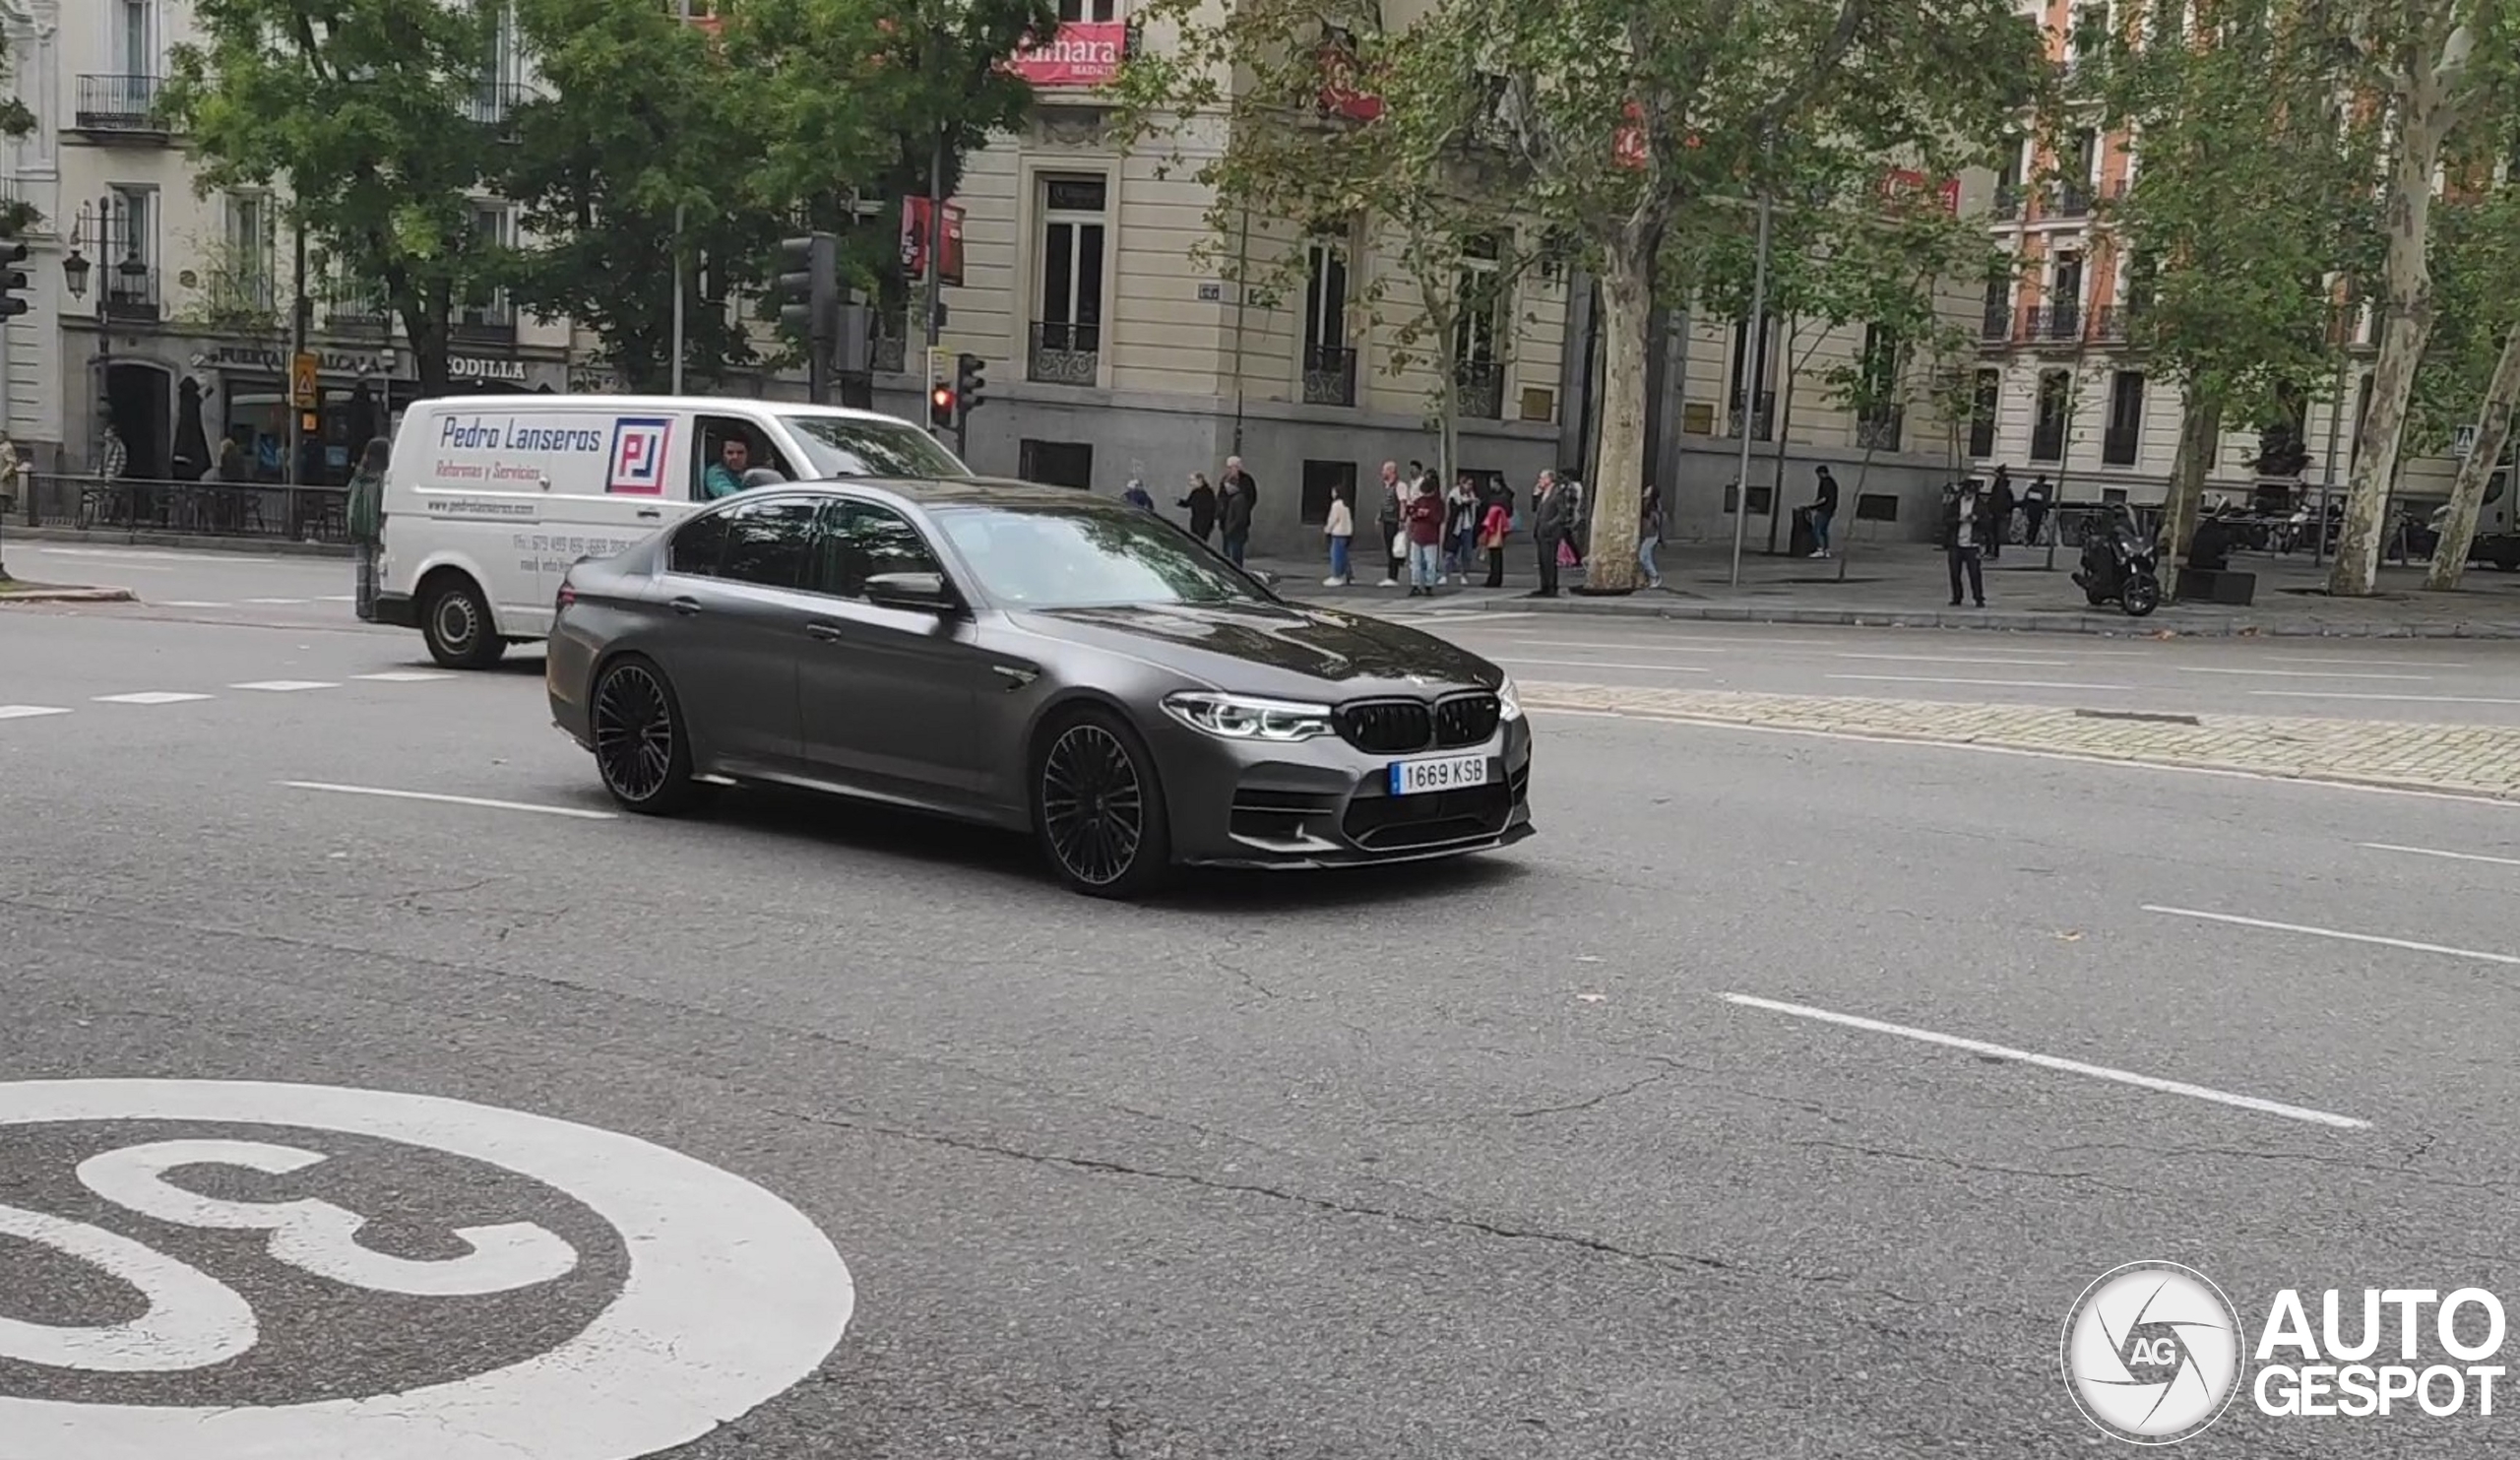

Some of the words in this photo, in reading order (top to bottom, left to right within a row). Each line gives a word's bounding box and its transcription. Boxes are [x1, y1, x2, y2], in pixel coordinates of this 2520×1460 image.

[447, 356, 527, 380] ODILLA
[440, 416, 500, 450] Pedro
[505, 417, 602, 453] Lanseros
[492, 461, 540, 481] Servicios
[1408, 764, 1448, 790] 1669
[1453, 759, 1483, 784] KSB
